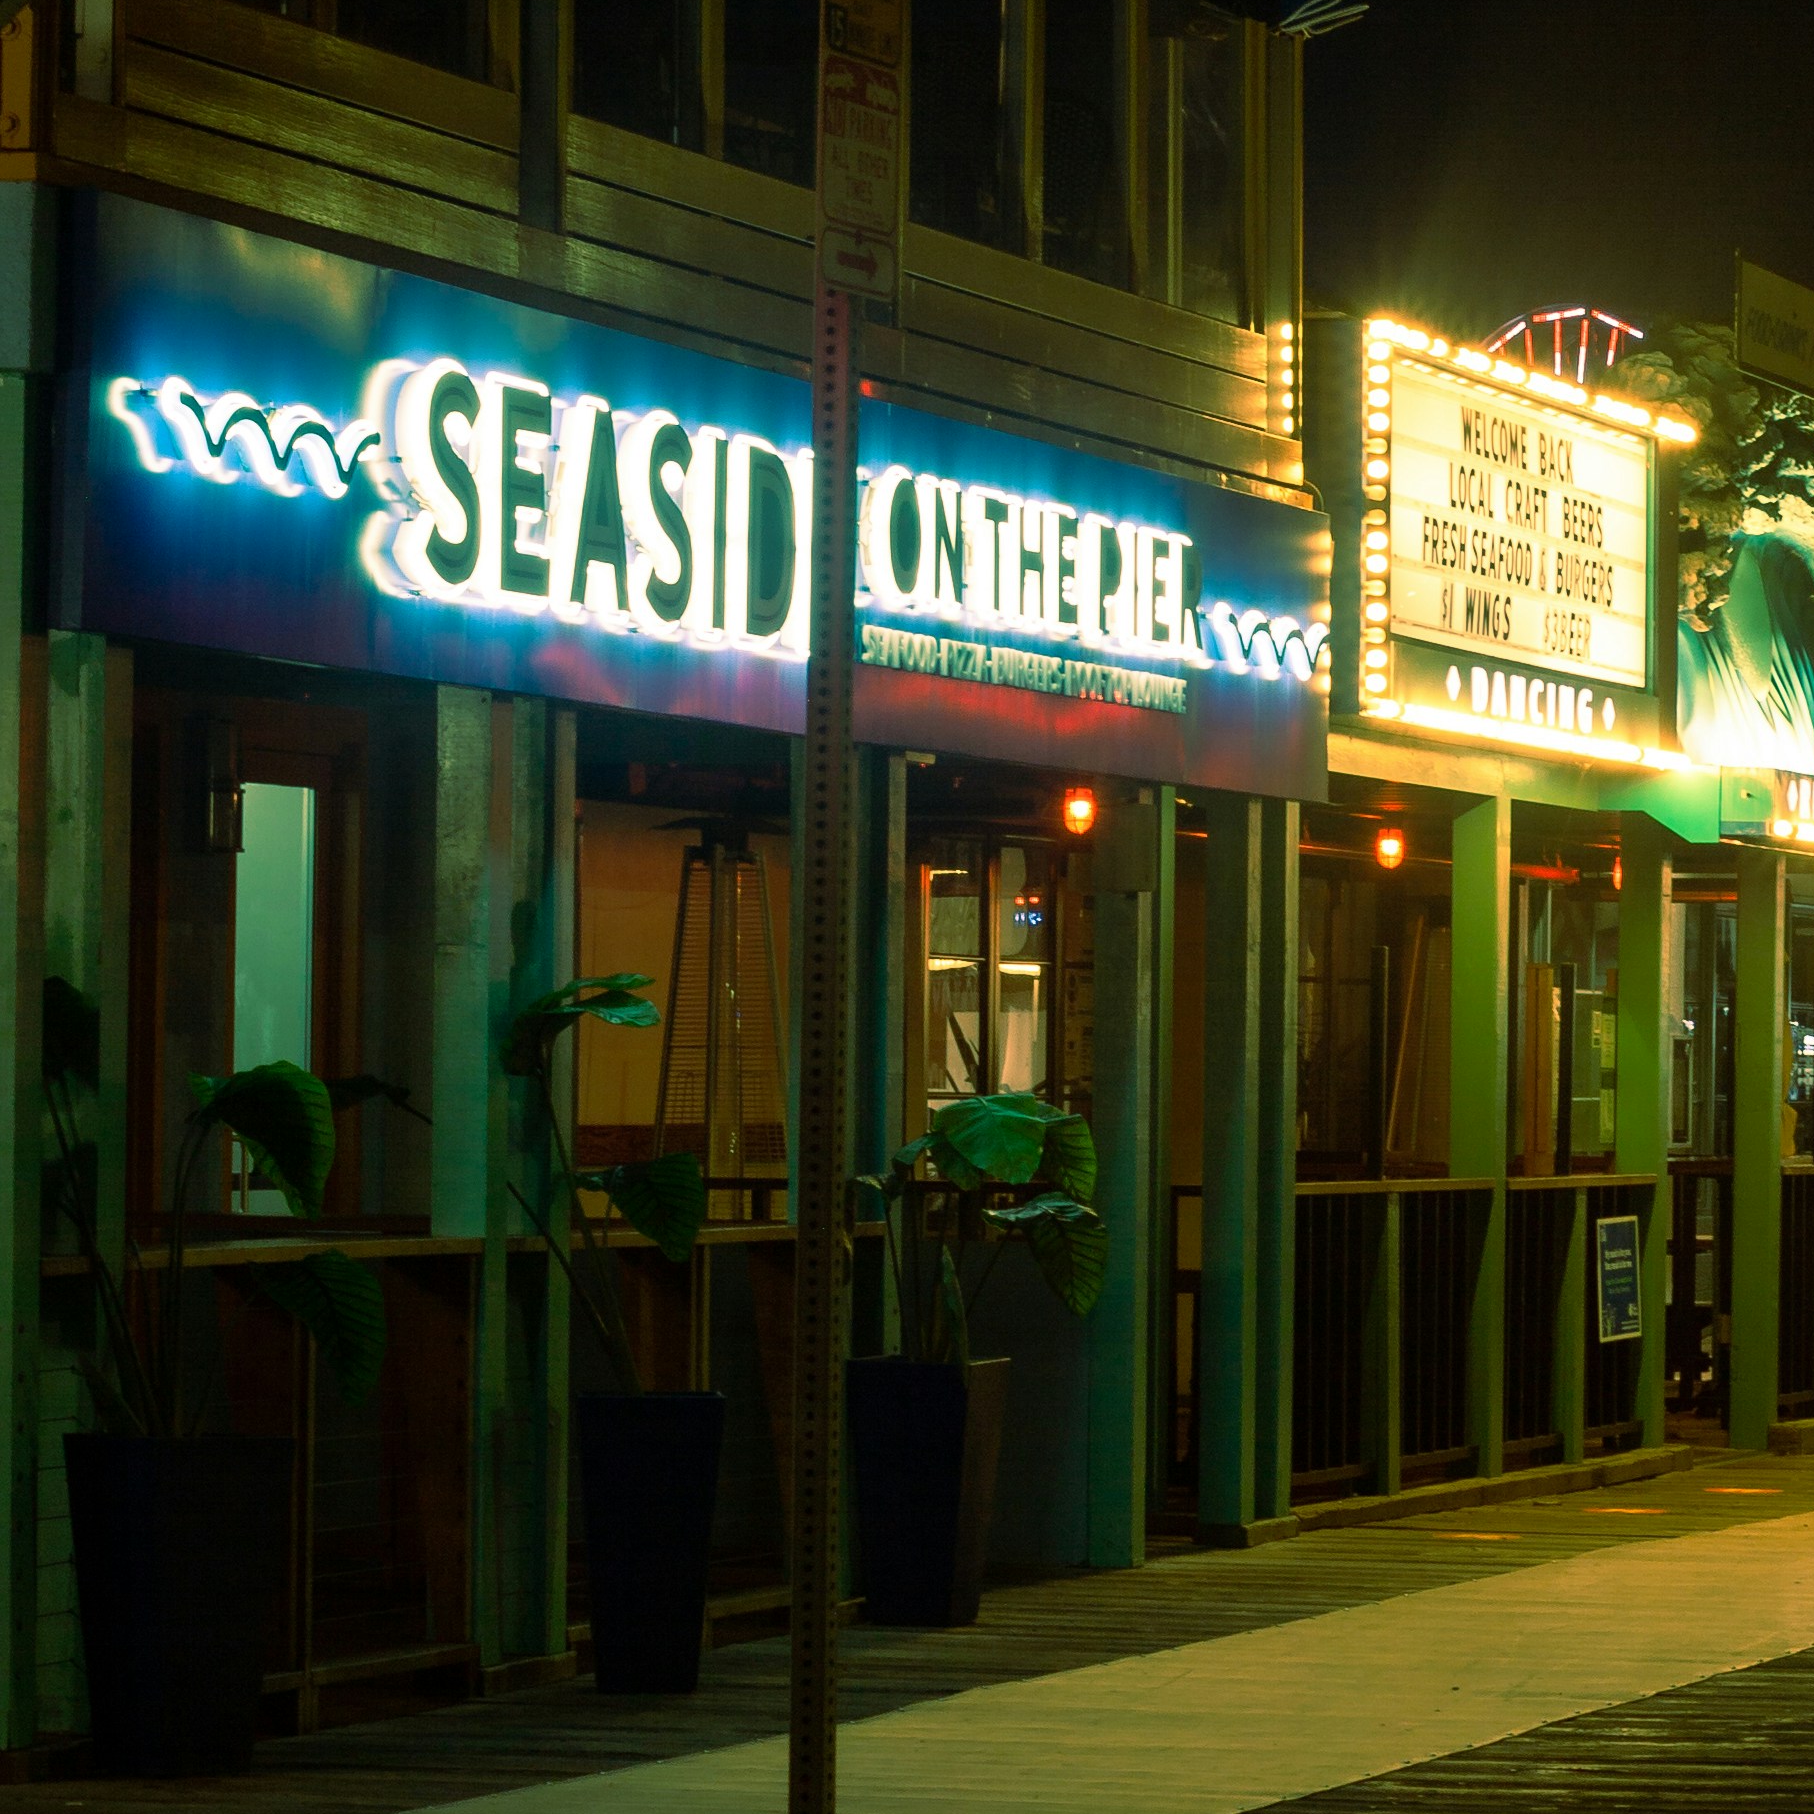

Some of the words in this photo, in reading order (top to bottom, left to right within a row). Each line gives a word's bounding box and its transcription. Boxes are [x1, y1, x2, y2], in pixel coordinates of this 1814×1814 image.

[1461, 406, 1527, 470] WELCOME
[1539, 433, 1574, 484] BACK
[372, 357, 818, 663] SEASID
[868, 465, 964, 615] ON
[968, 486, 1078, 635] THE
[1083, 514, 1203, 663] PIER
[1450, 462, 1494, 519] LOCAL
[1506, 480, 1547, 533] CRAFT
[1563, 497, 1604, 549] BEERS
[1423, 516, 1467, 571] FRESH
[1471, 529, 1533, 587] SEAFOOD
[1556, 551, 1613, 608] BURGERS
[1442, 582, 1454, 629] $1
[1465, 587, 1512, 641] WINGS
[1471, 666, 1594, 734] DANCING
